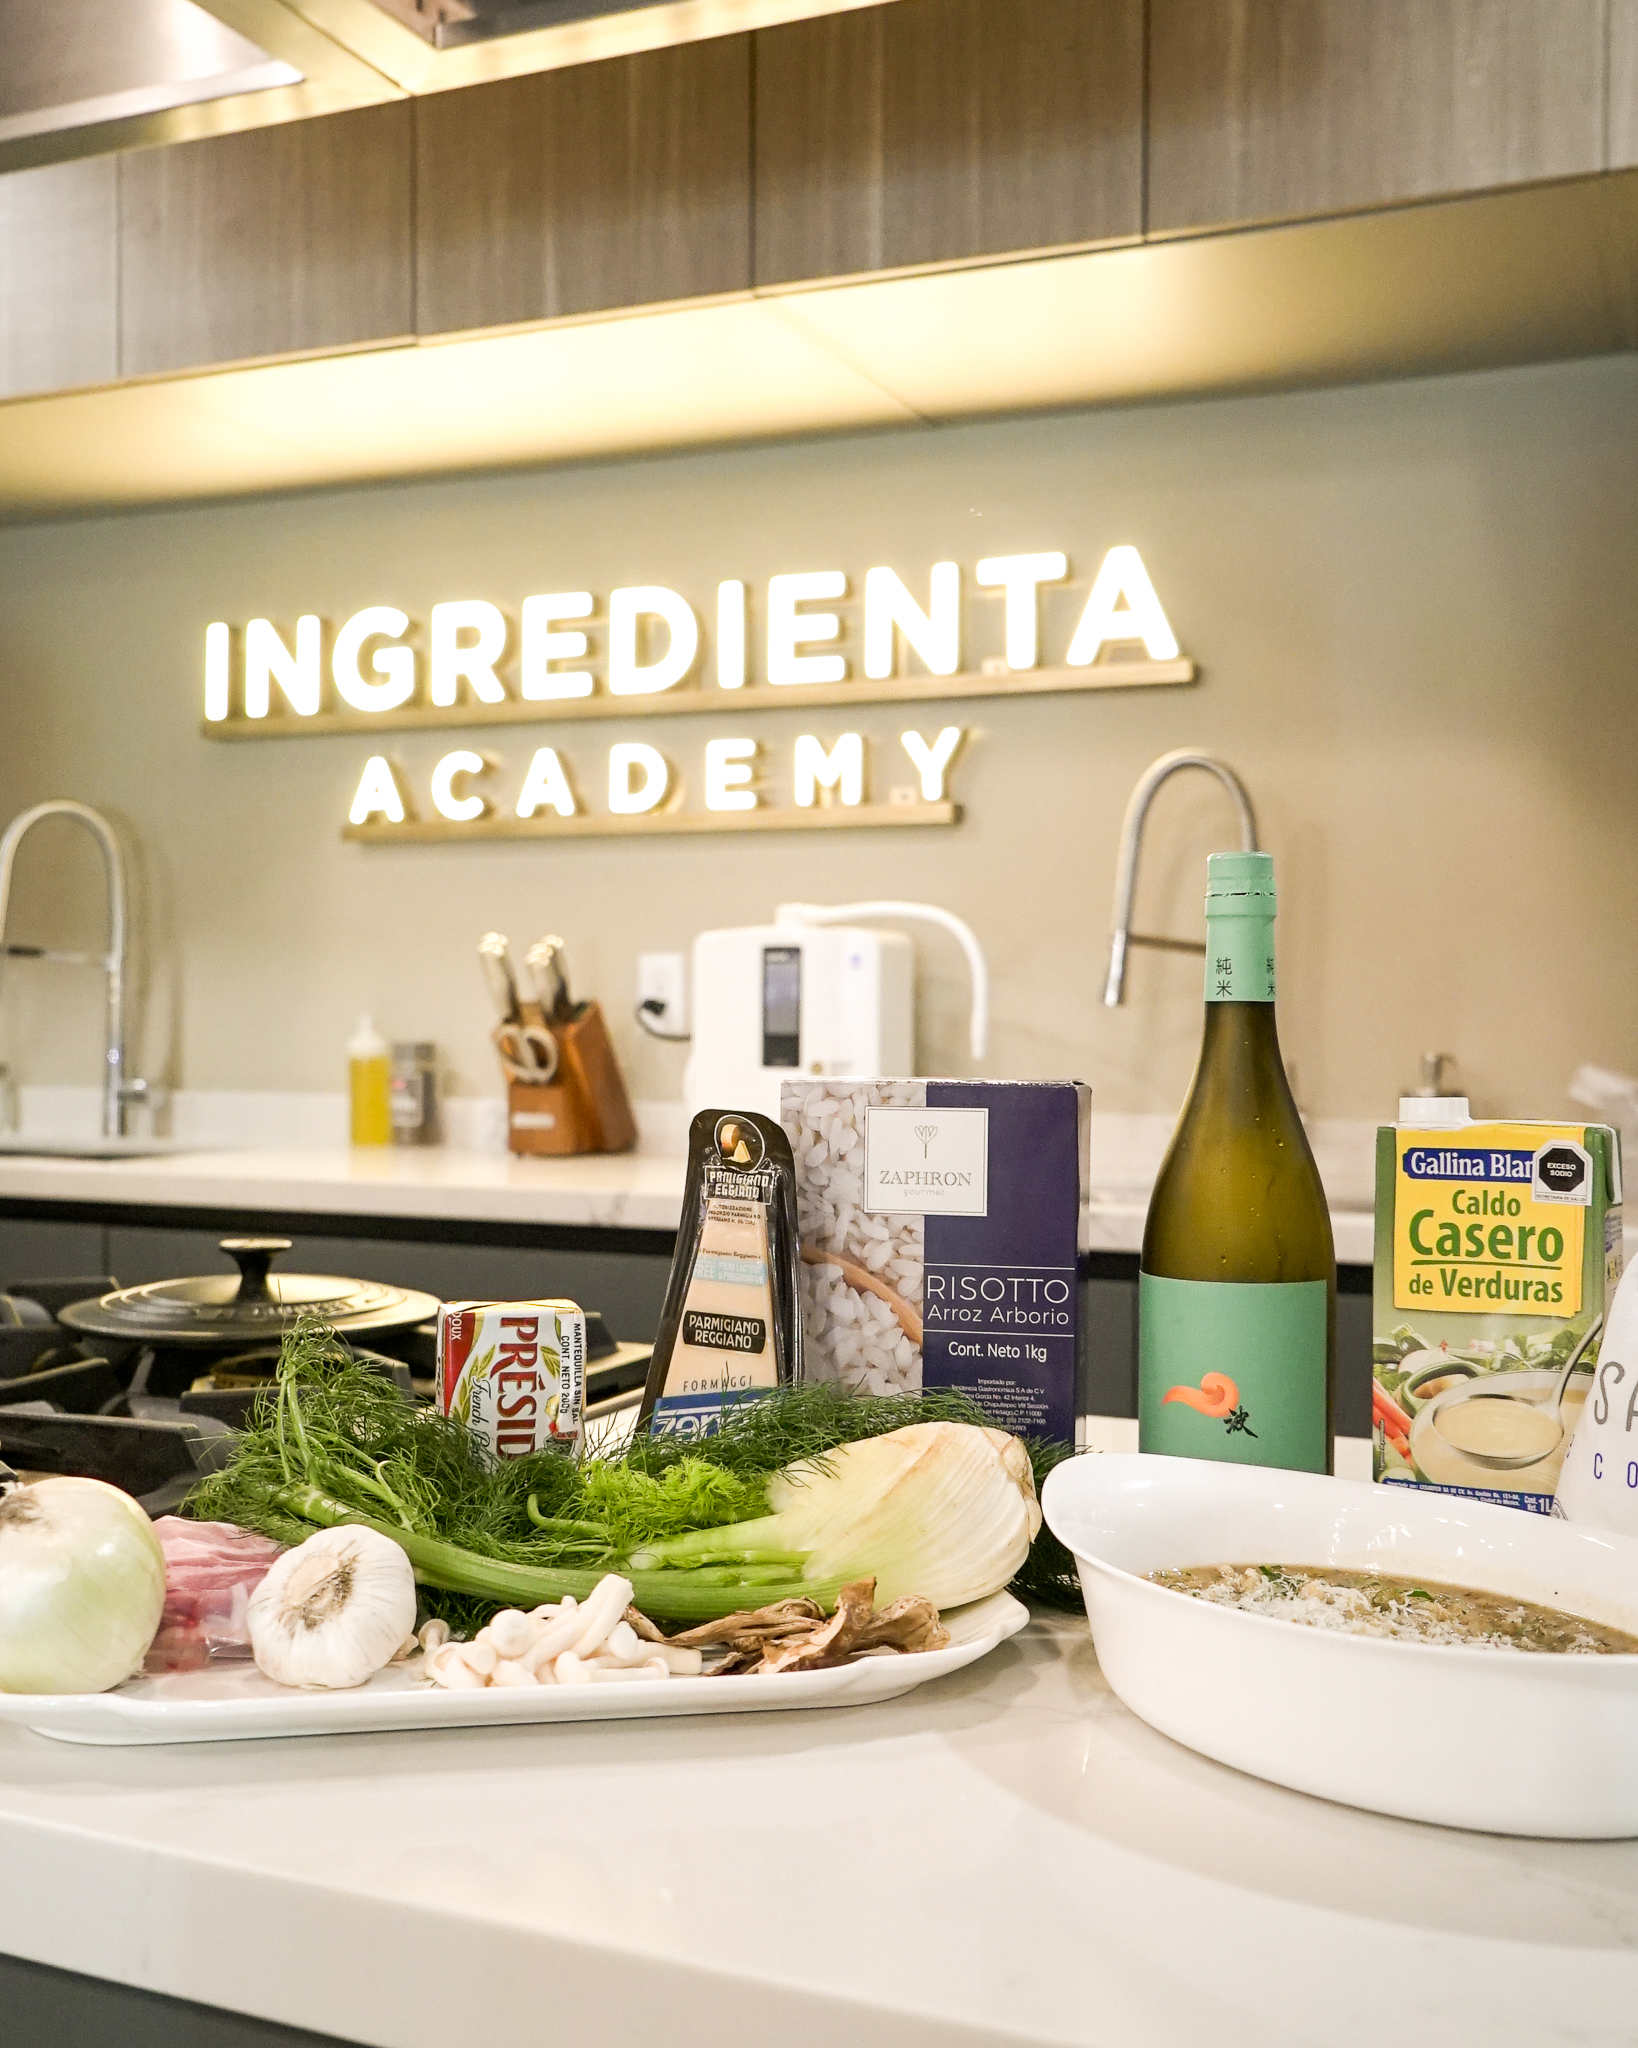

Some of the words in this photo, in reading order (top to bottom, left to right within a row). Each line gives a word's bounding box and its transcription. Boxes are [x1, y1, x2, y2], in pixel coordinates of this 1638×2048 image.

[204, 544, 1180, 721] INGREDIENTA
[348, 726, 961, 824] ACADEMY
[1215, 956, 1233, 997] 純米
[1410, 1151, 1485, 1176] Gallina
[1547, 1162, 1576, 1170] EXCESO
[879, 1170, 972, 1187] ZAPHRON
[903, 1188, 945, 1197] gourmet
[1452, 1189, 1521, 1216] Caldo
[1409, 1209, 1564, 1262] Casero
[927, 1275, 1070, 1304] RISOTTO
[1409, 1273, 1434, 1295] de
[1439, 1268, 1563, 1302] Verduras
[451, 1312, 463, 1340] DOUX
[689, 1314, 760, 1336] PARMIGIANO
[927, 1304, 982, 1322] Arroz
[990, 1306, 1069, 1325] Arborio
[561, 1336, 570, 1363] CONT.
[695, 1329, 752, 1348] REGGIANO
[573, 1323, 583, 1388] MANTEQUILLA
[948, 1341, 984, 1357] Cont.
[987, 1343, 1020, 1358] Neto
[1025, 1344, 1047, 1363] 1kg
[490, 1316, 546, 1461] PRÉSID
[561, 1366, 570, 1390] NETO
[683, 1374, 752, 1392] FORMAGGI
[472, 1377, 492, 1426] French
[573, 1389, 582, 1405] SIN
[572, 1408, 580, 1424] SAL
